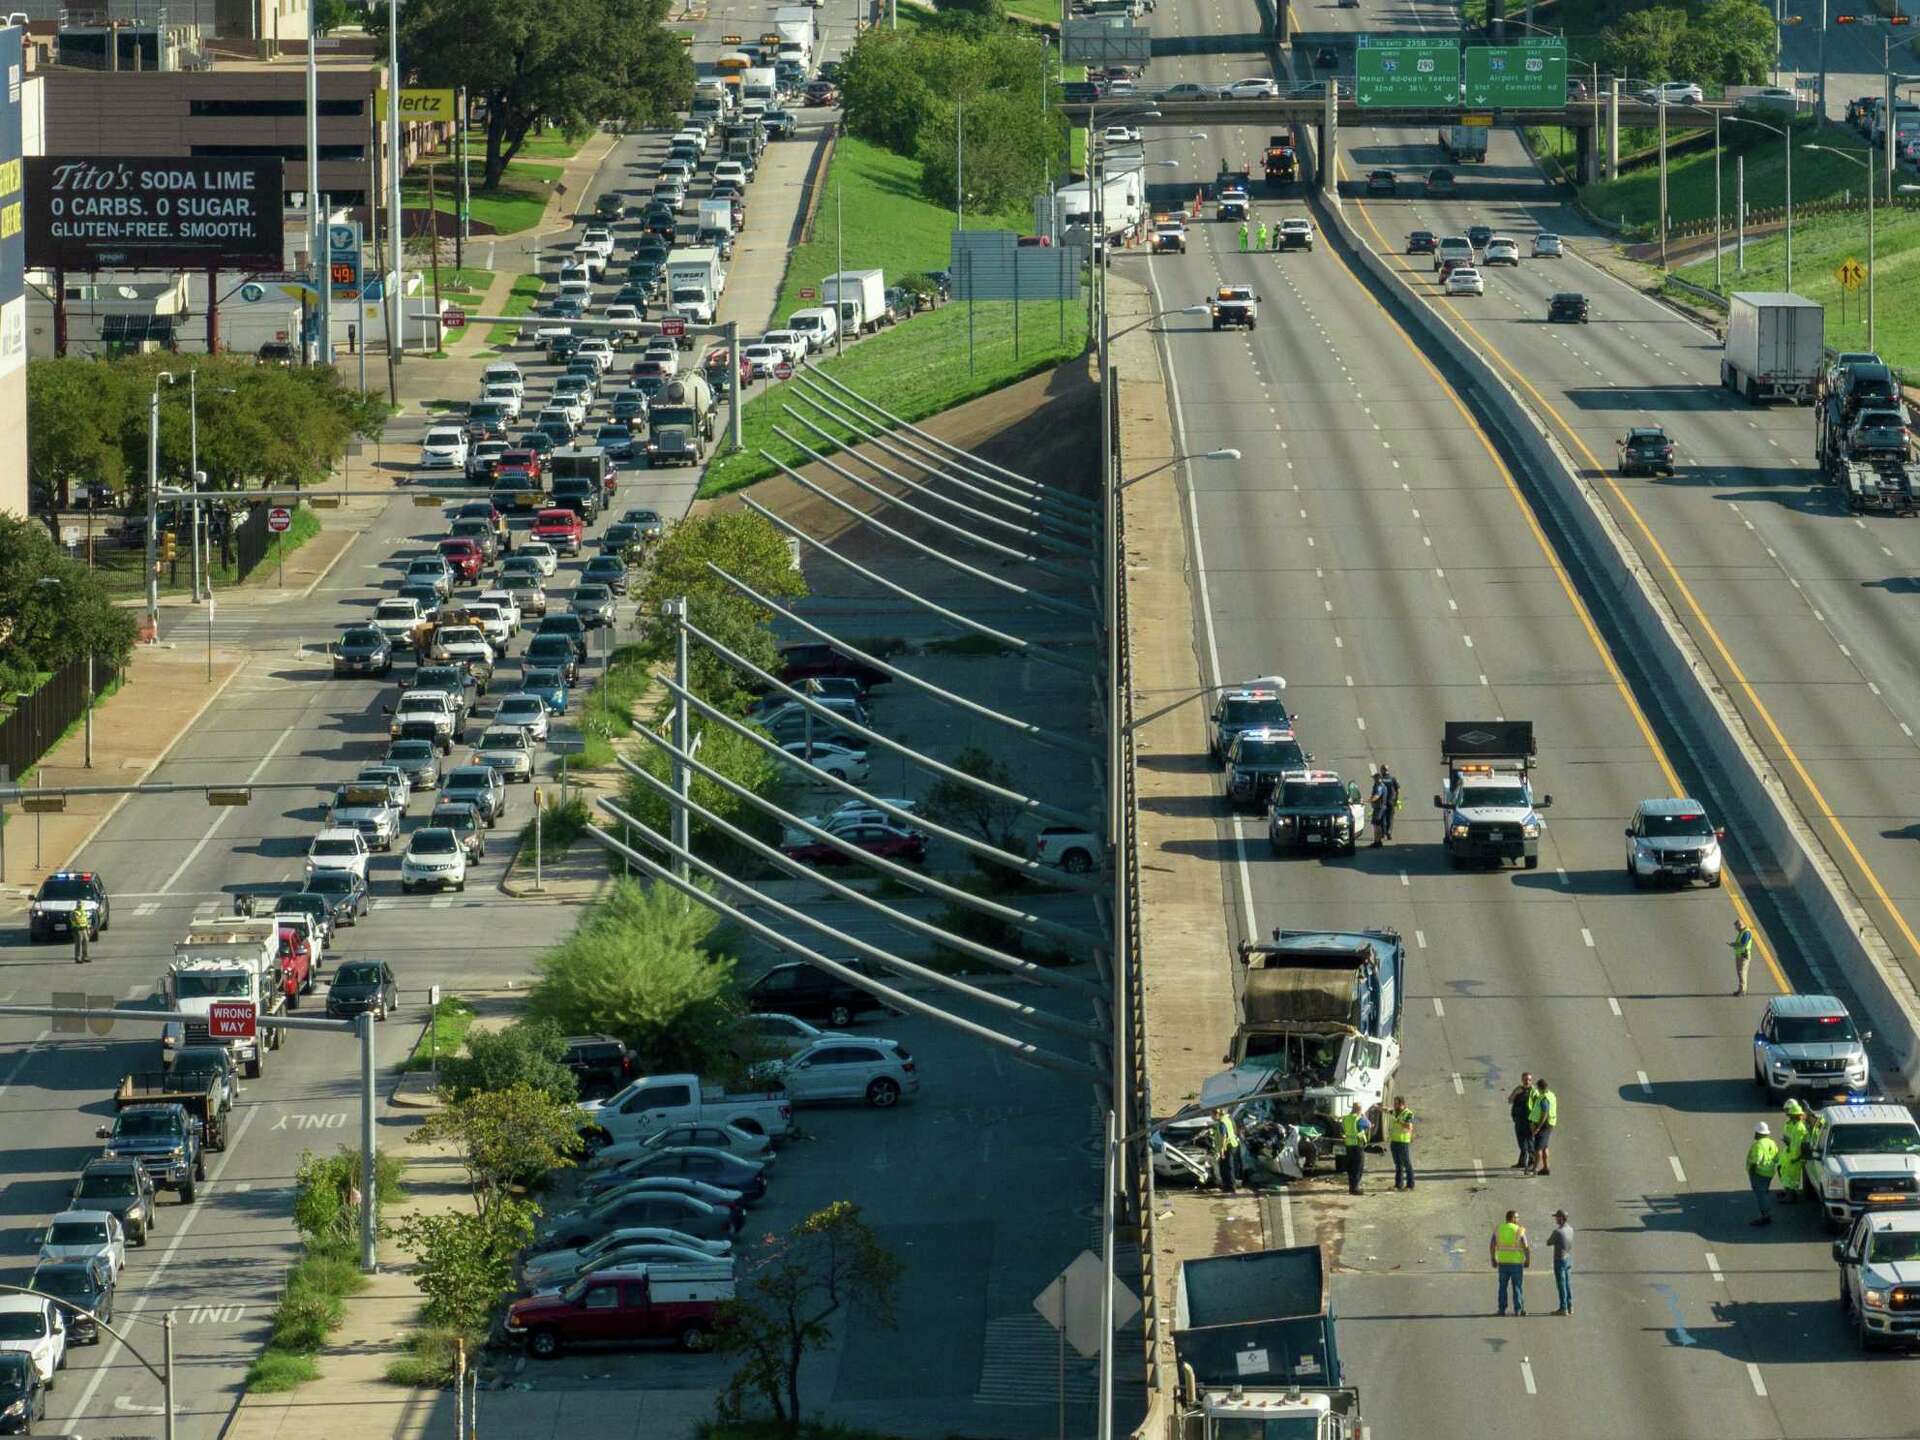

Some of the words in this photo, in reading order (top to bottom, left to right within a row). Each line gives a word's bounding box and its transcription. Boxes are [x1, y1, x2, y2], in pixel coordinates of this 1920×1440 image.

[51, 161, 133, 190] Tito's
[140, 171, 197, 190] SODA
[204, 171, 256, 190] LIME
[71, 197, 149, 216] CARBS.
[177, 197, 257, 217] SUGAR.
[51, 222, 174, 238] GLUTEN-FREE.
[179, 222, 257, 238] SMOOTH.
[213, 1007, 253, 1019] WRONG
[220, 1021, 246, 1033] WAY
[271, 1112, 348, 1131] ONLY
